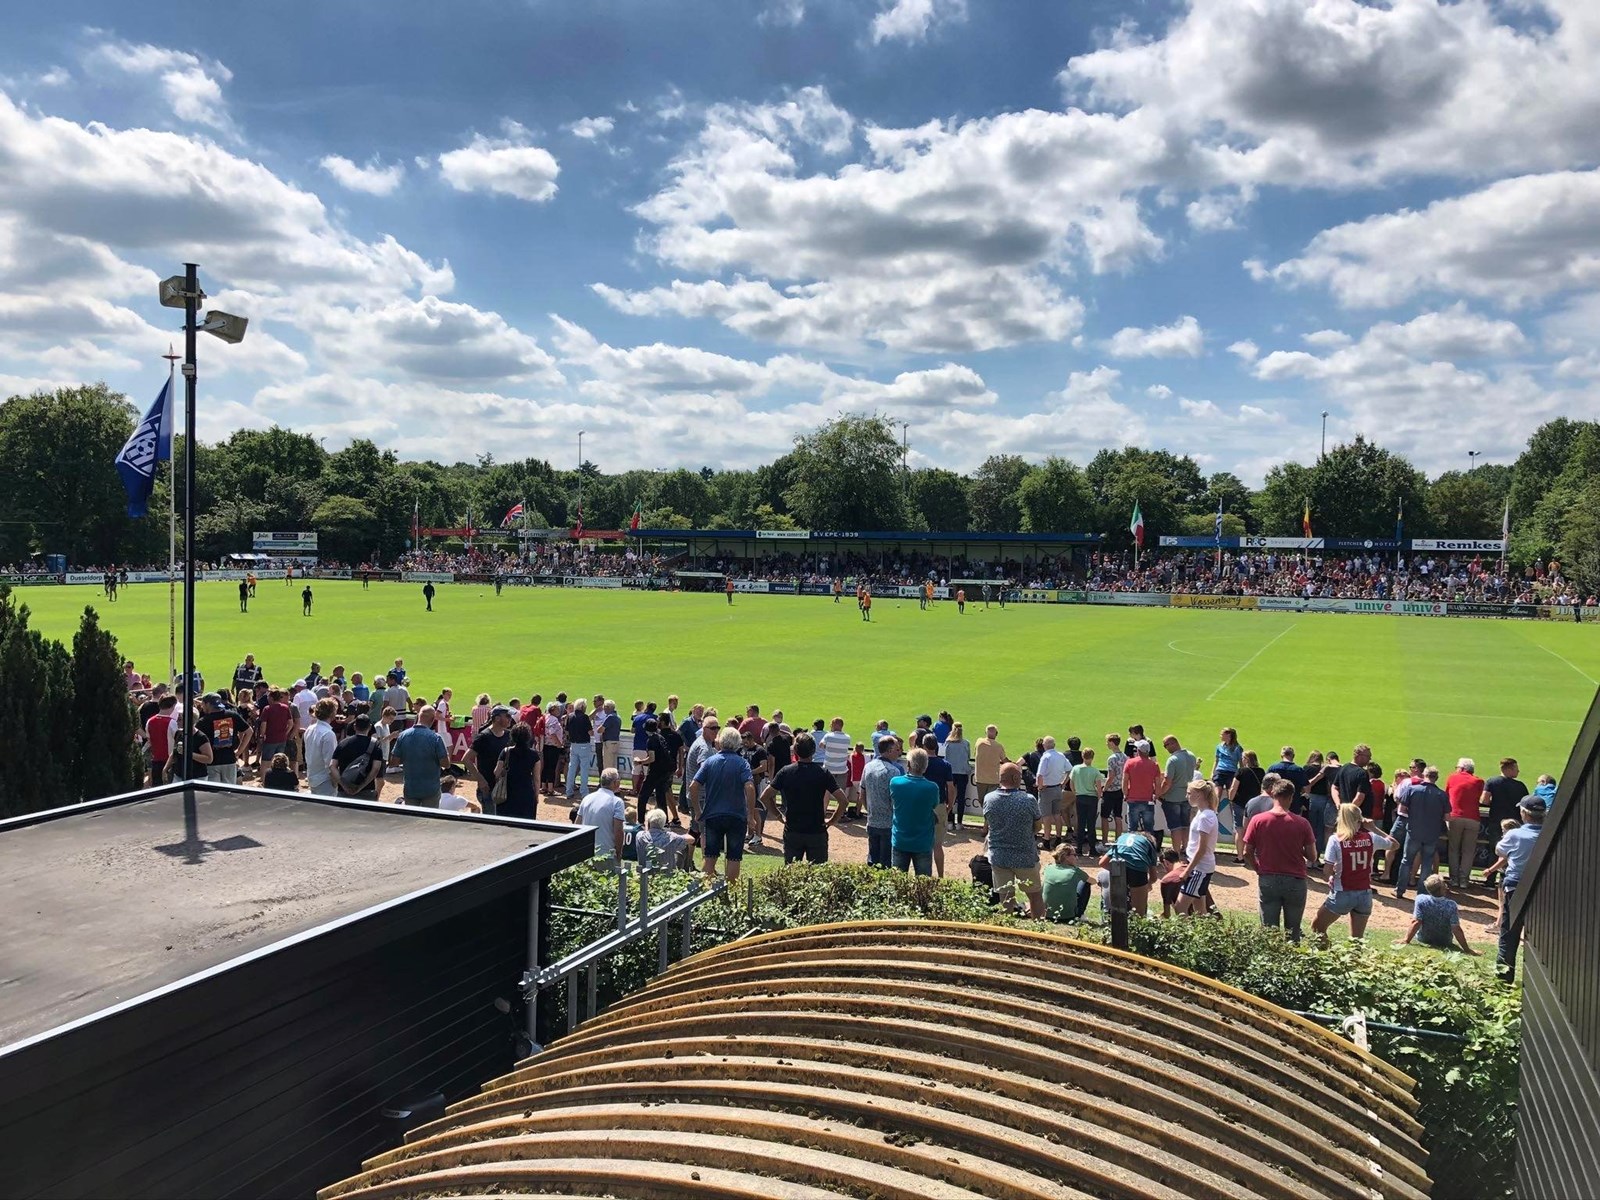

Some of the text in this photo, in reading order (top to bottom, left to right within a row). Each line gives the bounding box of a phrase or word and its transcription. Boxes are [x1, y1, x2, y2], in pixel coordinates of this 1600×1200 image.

[1246, 537, 1267, 547] R&C
[1436, 541, 1502, 549] Remkes
[1355, 601, 1392, 612] univé
[1403, 602, 1442, 613] univé
[1355, 838, 1372, 848] JONG
[1350, 851, 1368, 871] 14
